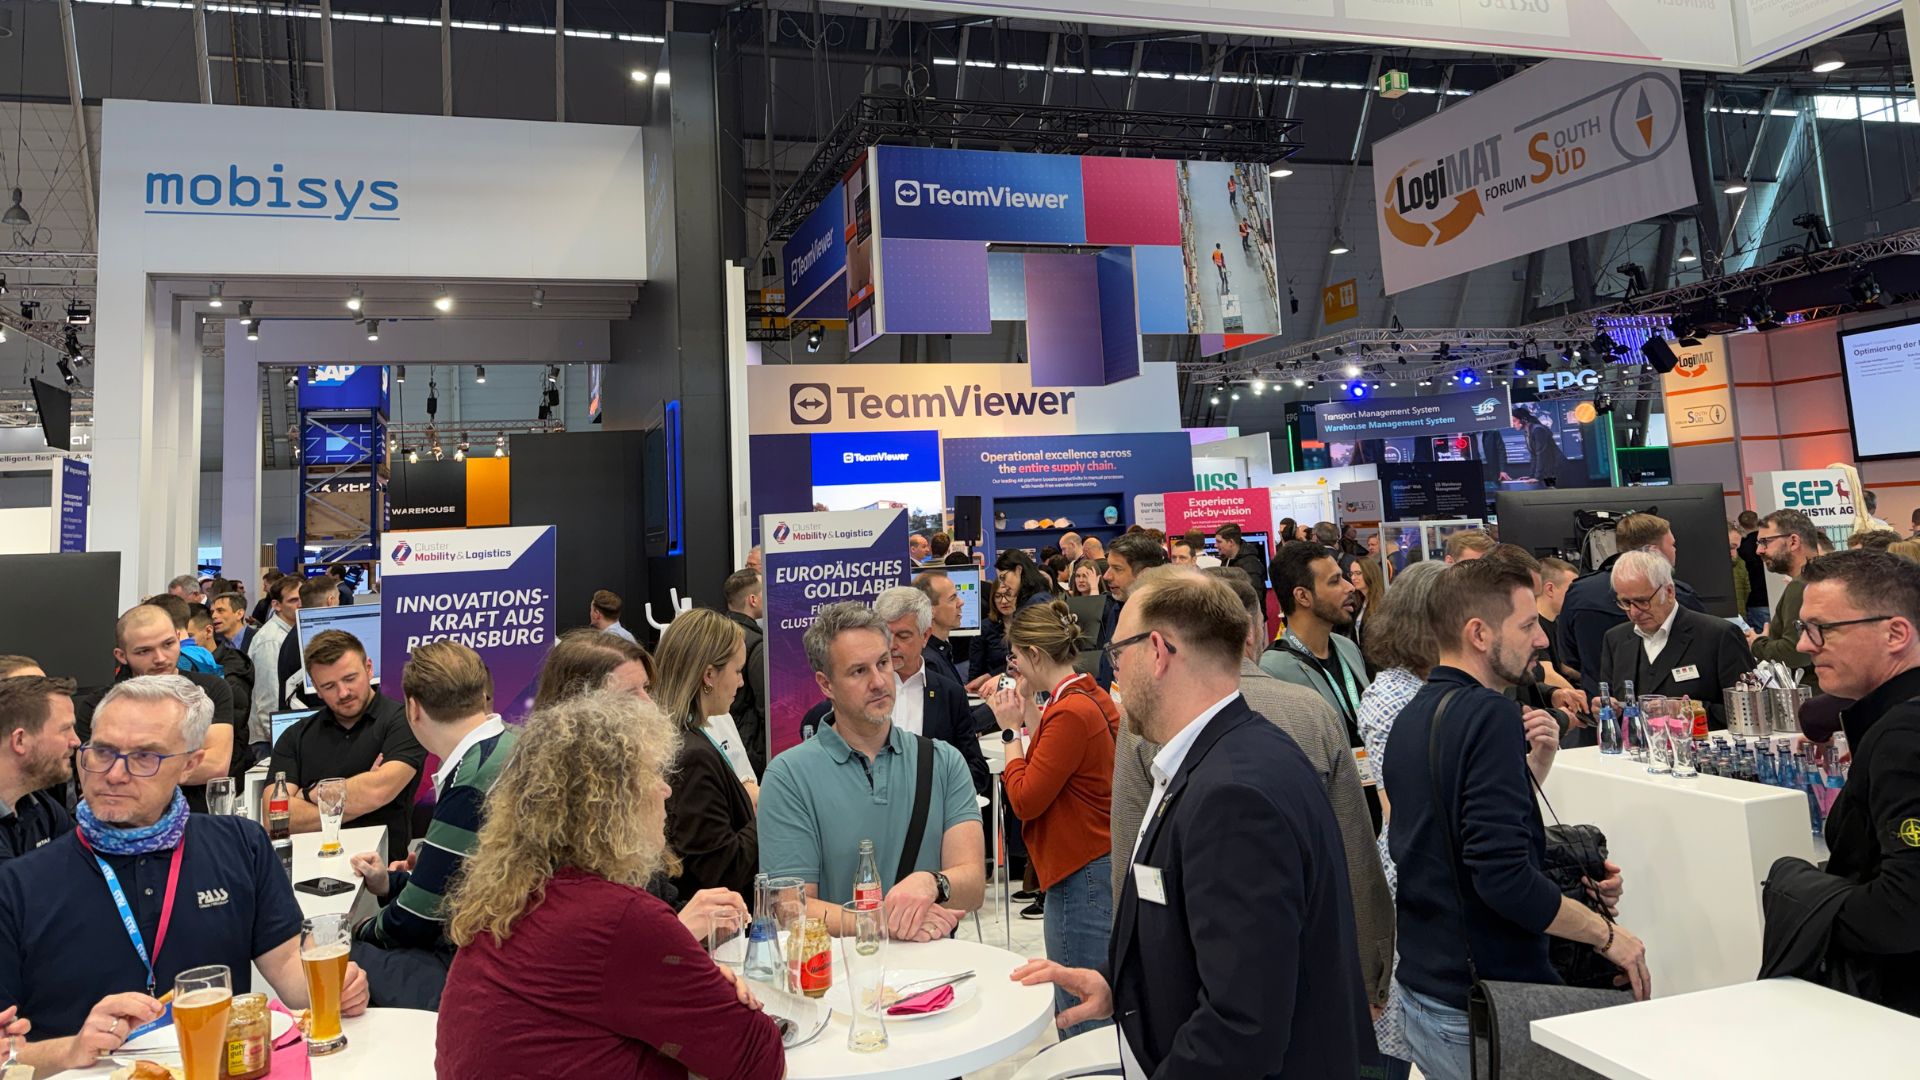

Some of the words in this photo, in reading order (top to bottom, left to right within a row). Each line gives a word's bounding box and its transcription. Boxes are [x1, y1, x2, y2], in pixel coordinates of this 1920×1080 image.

[1396, 135, 1502, 215] LogiMAT
[146, 164, 399, 220] mobisys
[1485, 175, 1527, 201] FORUM
[923, 183, 1068, 210] TeamViewer
[797, 227, 834, 277] TeamViewer
[1853, 344, 1902, 356] Optimierung
[1679, 351, 1714, 367] LogiMAT
[1537, 369, 1598, 392] EPG
[836, 385, 1075, 420] TeamViewer
[1323, 411, 1356, 421] Transport
[1358, 407, 1409, 419] Management
[1411, 405, 1440, 416] System
[1324, 423, 1366, 432] Warehouse
[1369, 418, 1425, 430] Management
[1427, 416, 1455, 426] System
[853, 452, 909, 462] TeamViewer
[981, 450, 1043, 463] Operational
[1045, 449, 1098, 460] excellence
[1100, 449, 1132, 458] across
[998, 463, 1016, 474] the
[1019, 463, 1050, 473] entire
[1051, 461, 1085, 473] supply
[1087, 461, 1117, 470] chain.
[1782, 480, 1833, 507] SEP
[391, 505, 456, 516] WAREHOUSE
[1188, 496, 1245, 509] Experience
[1183, 507, 1251, 519] pick-by-vision
[1799, 507, 1837, 517] GISTIK
[1839, 506, 1855, 515] AG
[792, 523, 823, 531] Cluster
[792, 531, 827, 541] Mobility
[834, 529, 873, 540] Logistics
[414, 542, 450, 552] Cluster
[414, 552, 456, 562] Mobility
[457, 552, 464, 560] &
[465, 549, 512, 560] Logistics
[776, 560, 903, 583] EUROPÄISCHES
[396, 588, 549, 614] INNOVATIONS-
[429, 610, 499, 631] KRAFT
[503, 607, 545, 626] AUS
[197, 888, 228, 904] PASS
